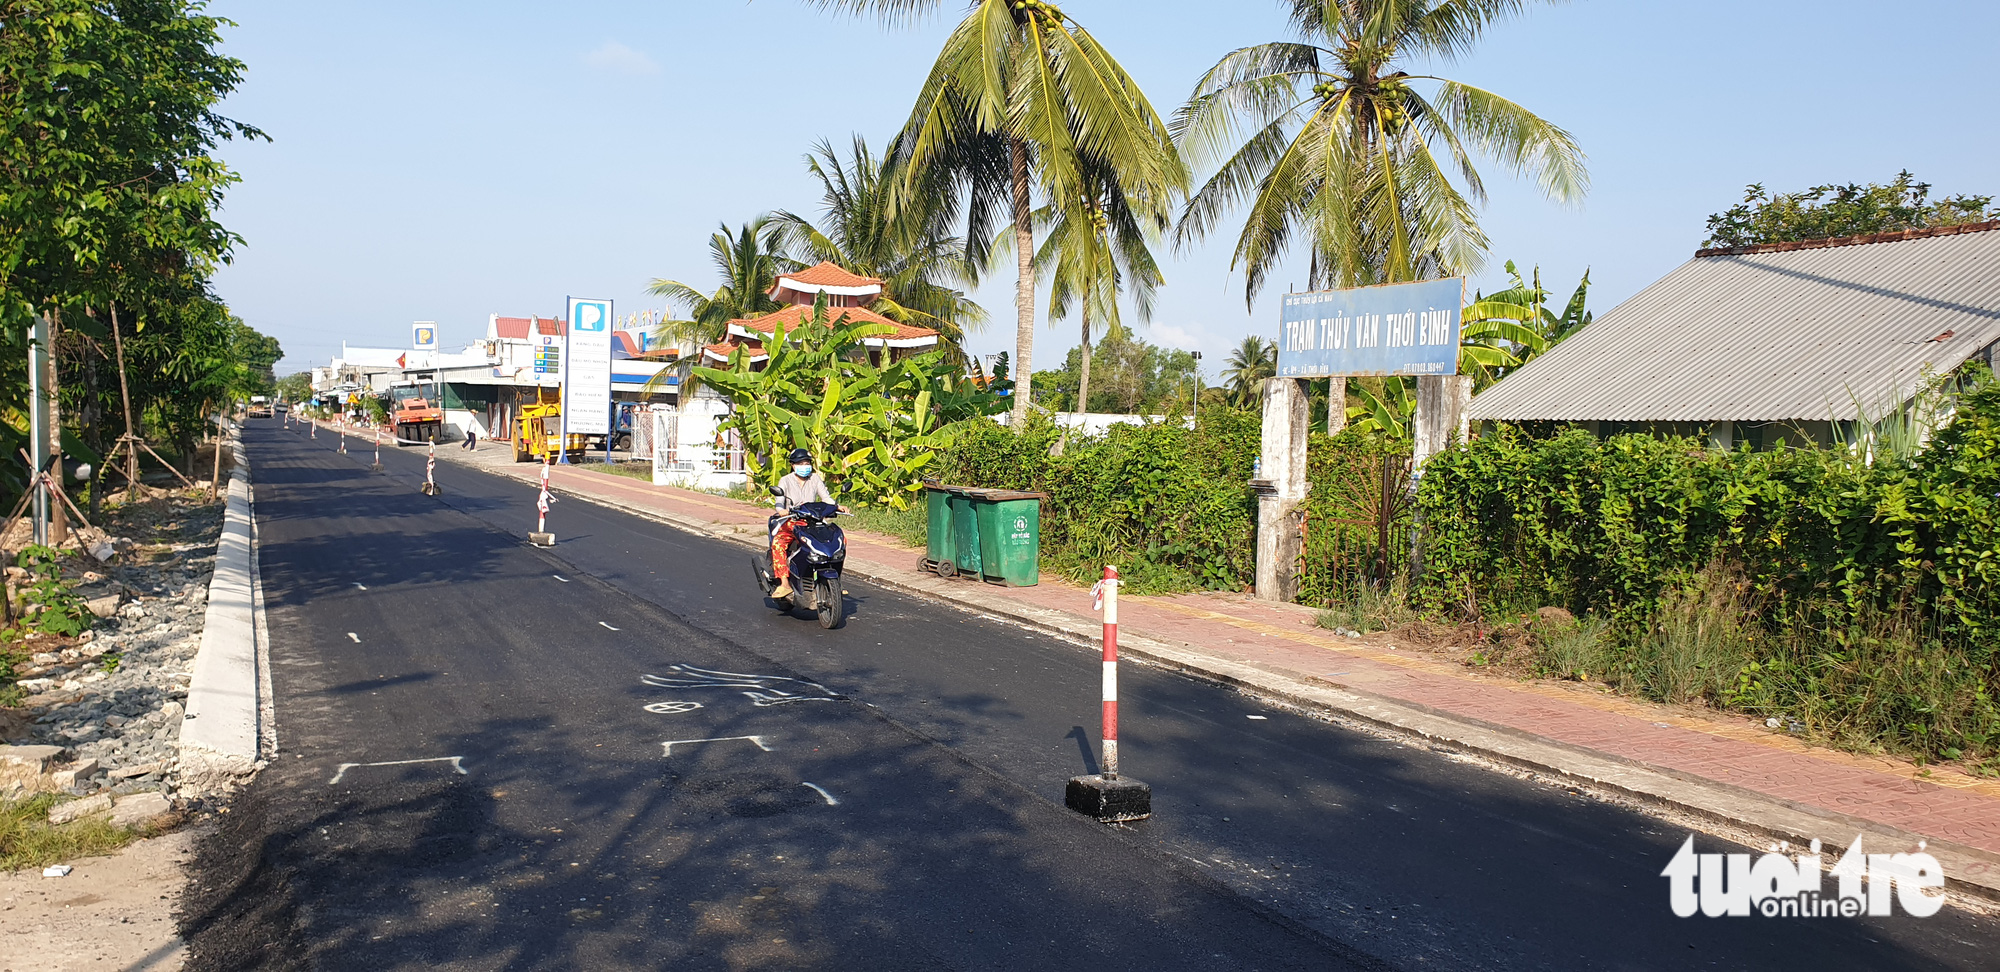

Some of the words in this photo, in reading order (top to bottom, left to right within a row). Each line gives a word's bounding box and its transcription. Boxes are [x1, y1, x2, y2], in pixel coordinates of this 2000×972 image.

[1286, 318, 1315, 353] TRẠM
[1320, 310, 1350, 349] THỦY
[1356, 312, 1379, 348] VĂN
[1386, 308, 1415, 347] THỚI
[1420, 306, 1451, 346] BÌNH
